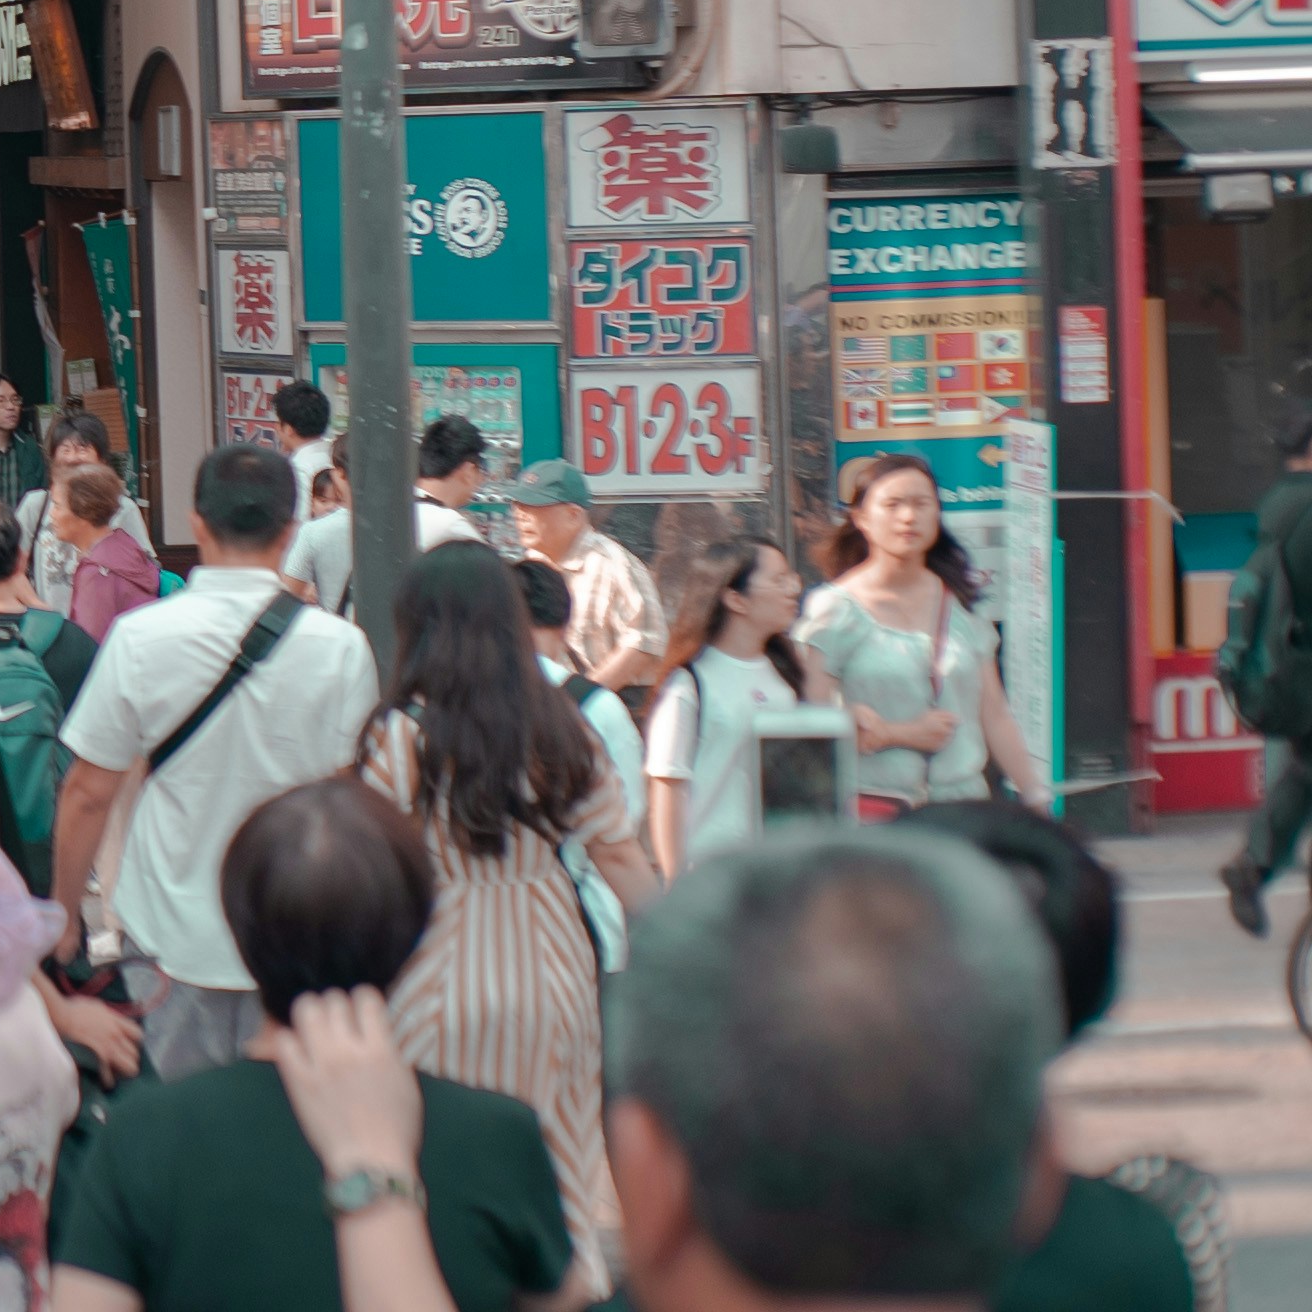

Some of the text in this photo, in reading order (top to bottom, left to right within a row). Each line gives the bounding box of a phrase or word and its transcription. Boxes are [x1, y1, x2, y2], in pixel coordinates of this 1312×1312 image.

[603, 124, 712, 216] 薬
[828, 200, 1026, 234] CURRENCY
[575, 244, 749, 307] ダイコク
[829, 240, 1027, 275] EXCHANGE
[594, 307, 725, 355] ドラッグ
[839, 314, 869, 331] NO
